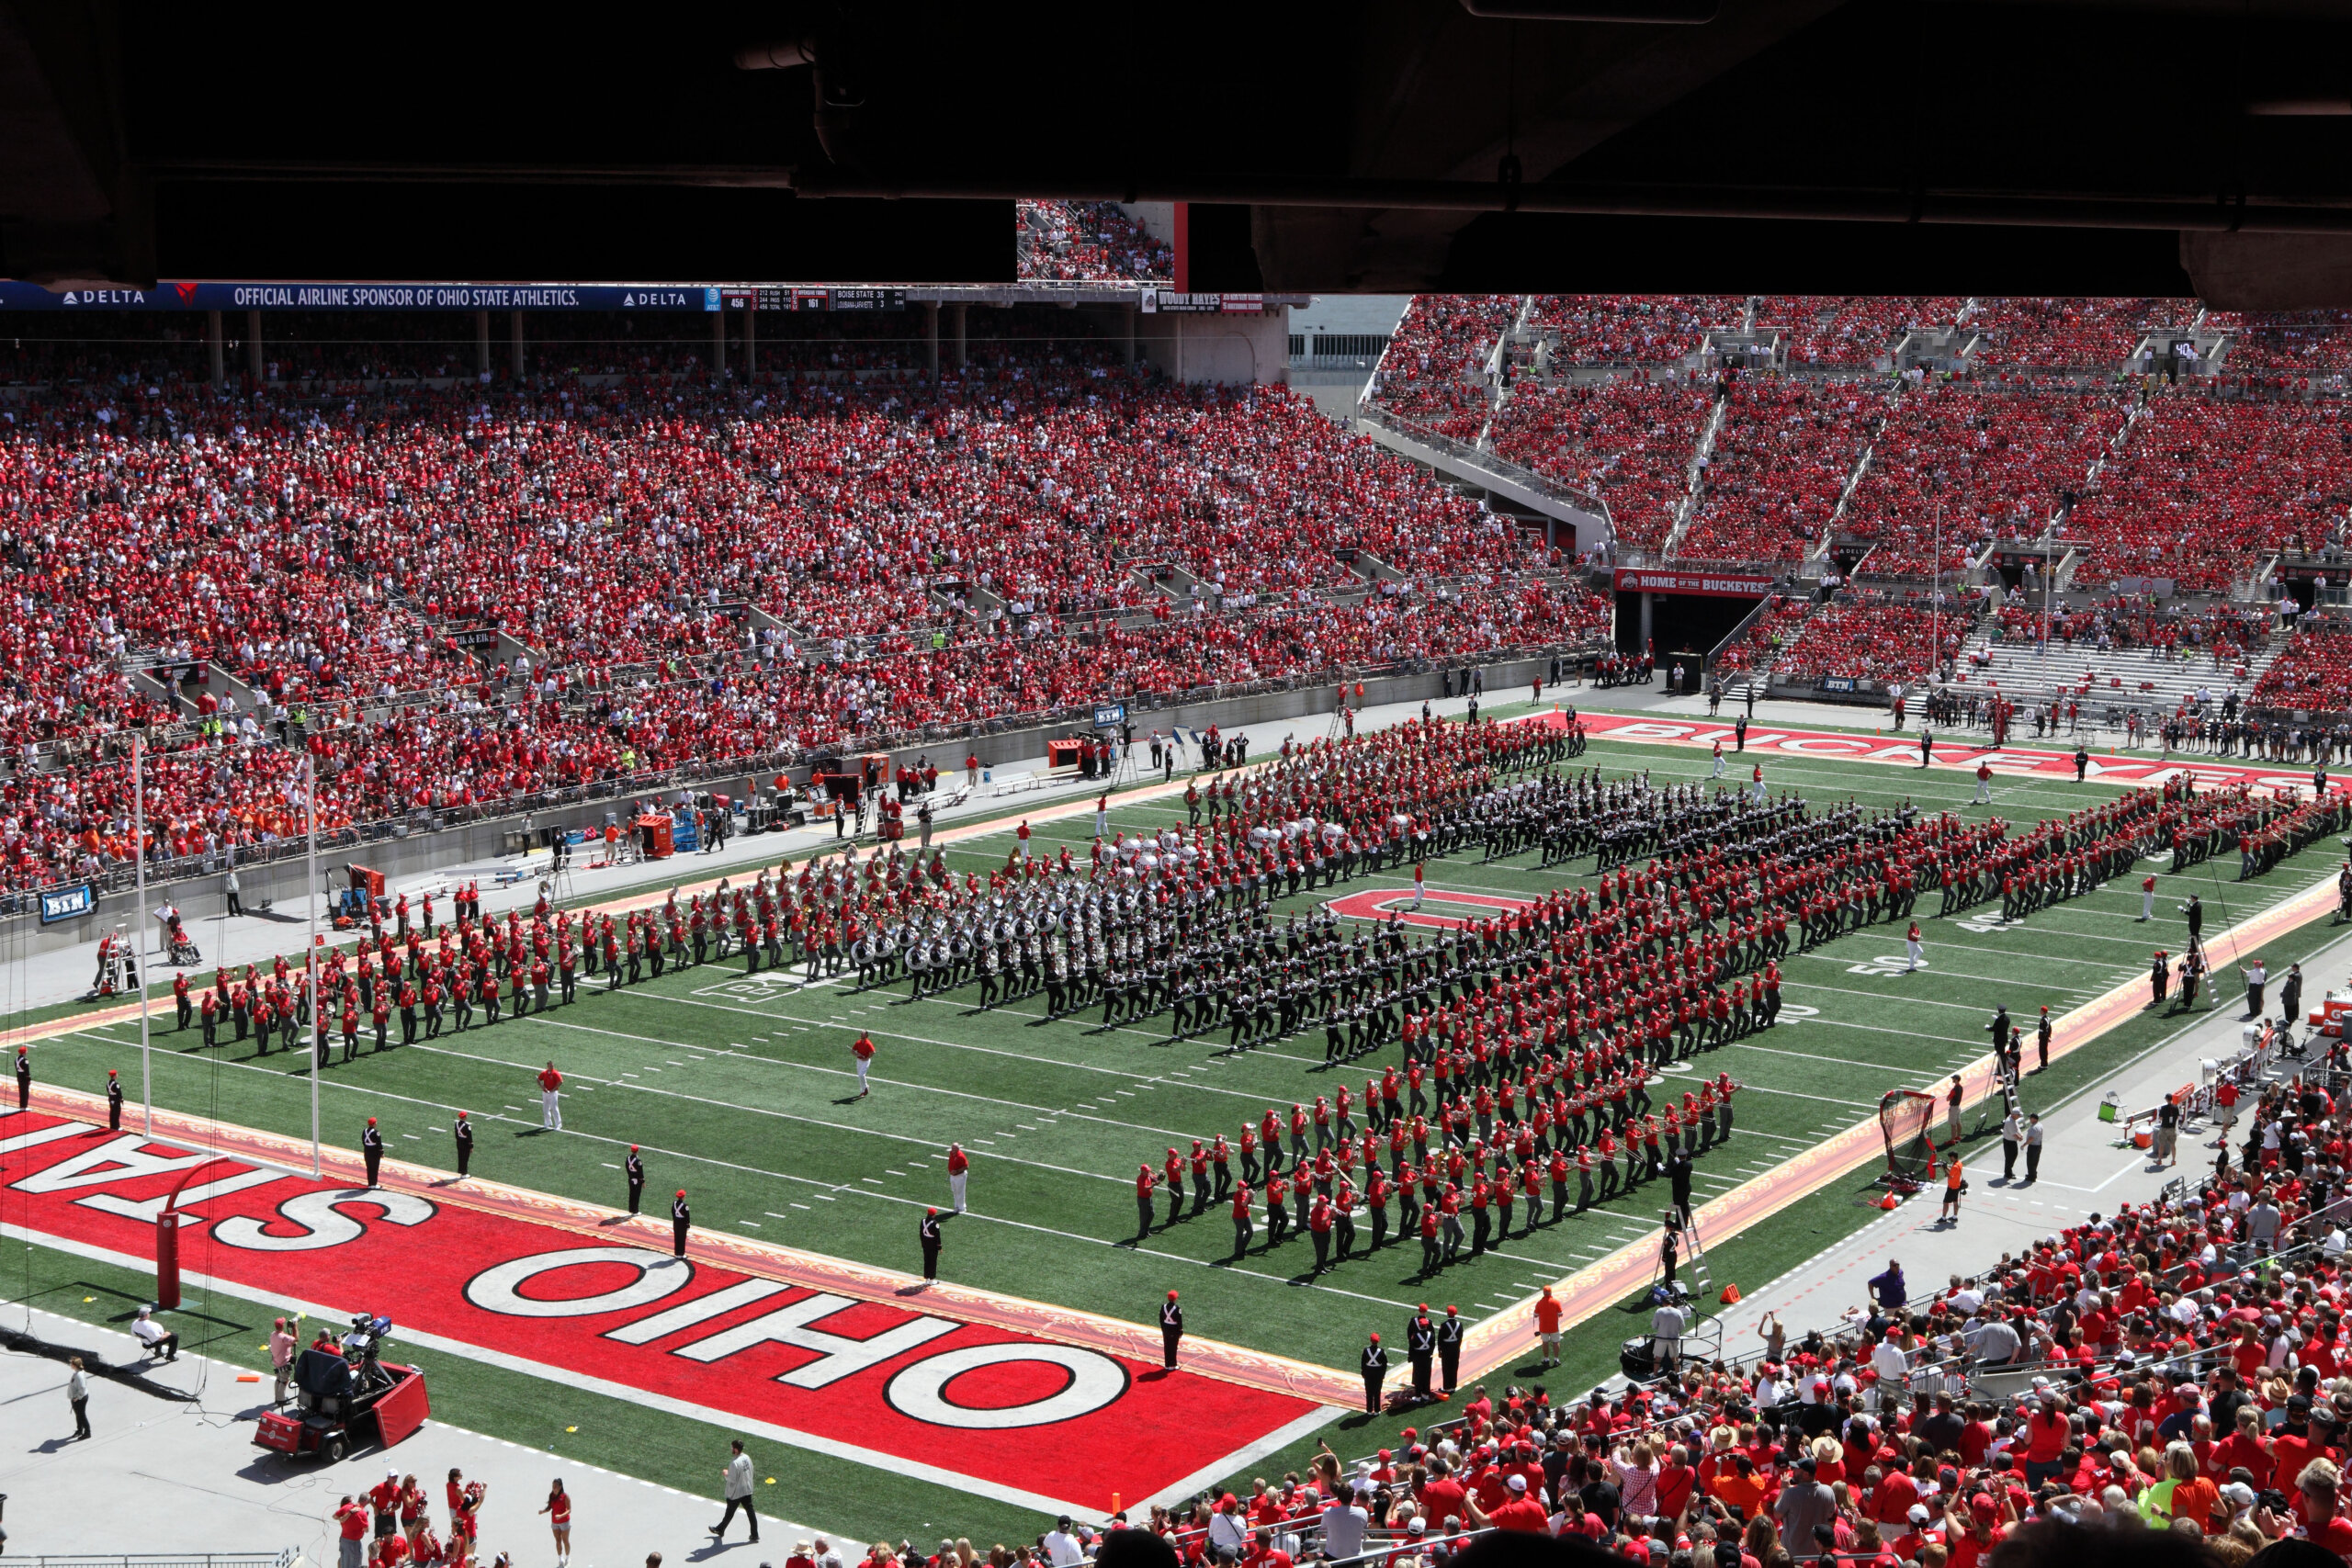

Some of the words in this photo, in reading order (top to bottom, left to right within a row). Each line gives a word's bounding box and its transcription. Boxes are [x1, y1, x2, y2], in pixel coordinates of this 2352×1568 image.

[84, 290, 145, 304] DELTA
[234, 288, 294, 306] OFFICIAL
[298, 288, 349, 306] AIRLINE
[352, 288, 413, 306] SPONSOR
[416, 289, 434, 306] OF
[436, 289, 469, 306] OHIO
[472, 289, 509, 306] STATE
[513, 289, 580, 306] ATHLETICS.
[639, 293, 686, 305] DELTA
[837, 290, 854, 299] BOISE
[856, 290, 874, 299] STATE
[1158, 292, 1190, 305] WOODY
[1192, 293, 1220, 305] HAYES
[730, 298, 744, 308] 456
[808, 299, 819, 308] 161
[2176, 344, 2189, 355] 40
[1641, 576, 1676, 588] HOME
[1702, 580, 1764, 592] BUCKEYES
[455, 636, 467, 645] Elk
[476, 634, 489, 643] Elk
[1826, 680, 1849, 690] BTN
[1097, 708, 1120, 723] BTN
[1599, 722, 2344, 795] BUCKEYES
[47, 890, 85, 916] BTN
[2331, 1009, 2341, 1020] G
[1729, 1285, 1738, 1299] 10
[461, 1246, 1130, 1430] OHIO
